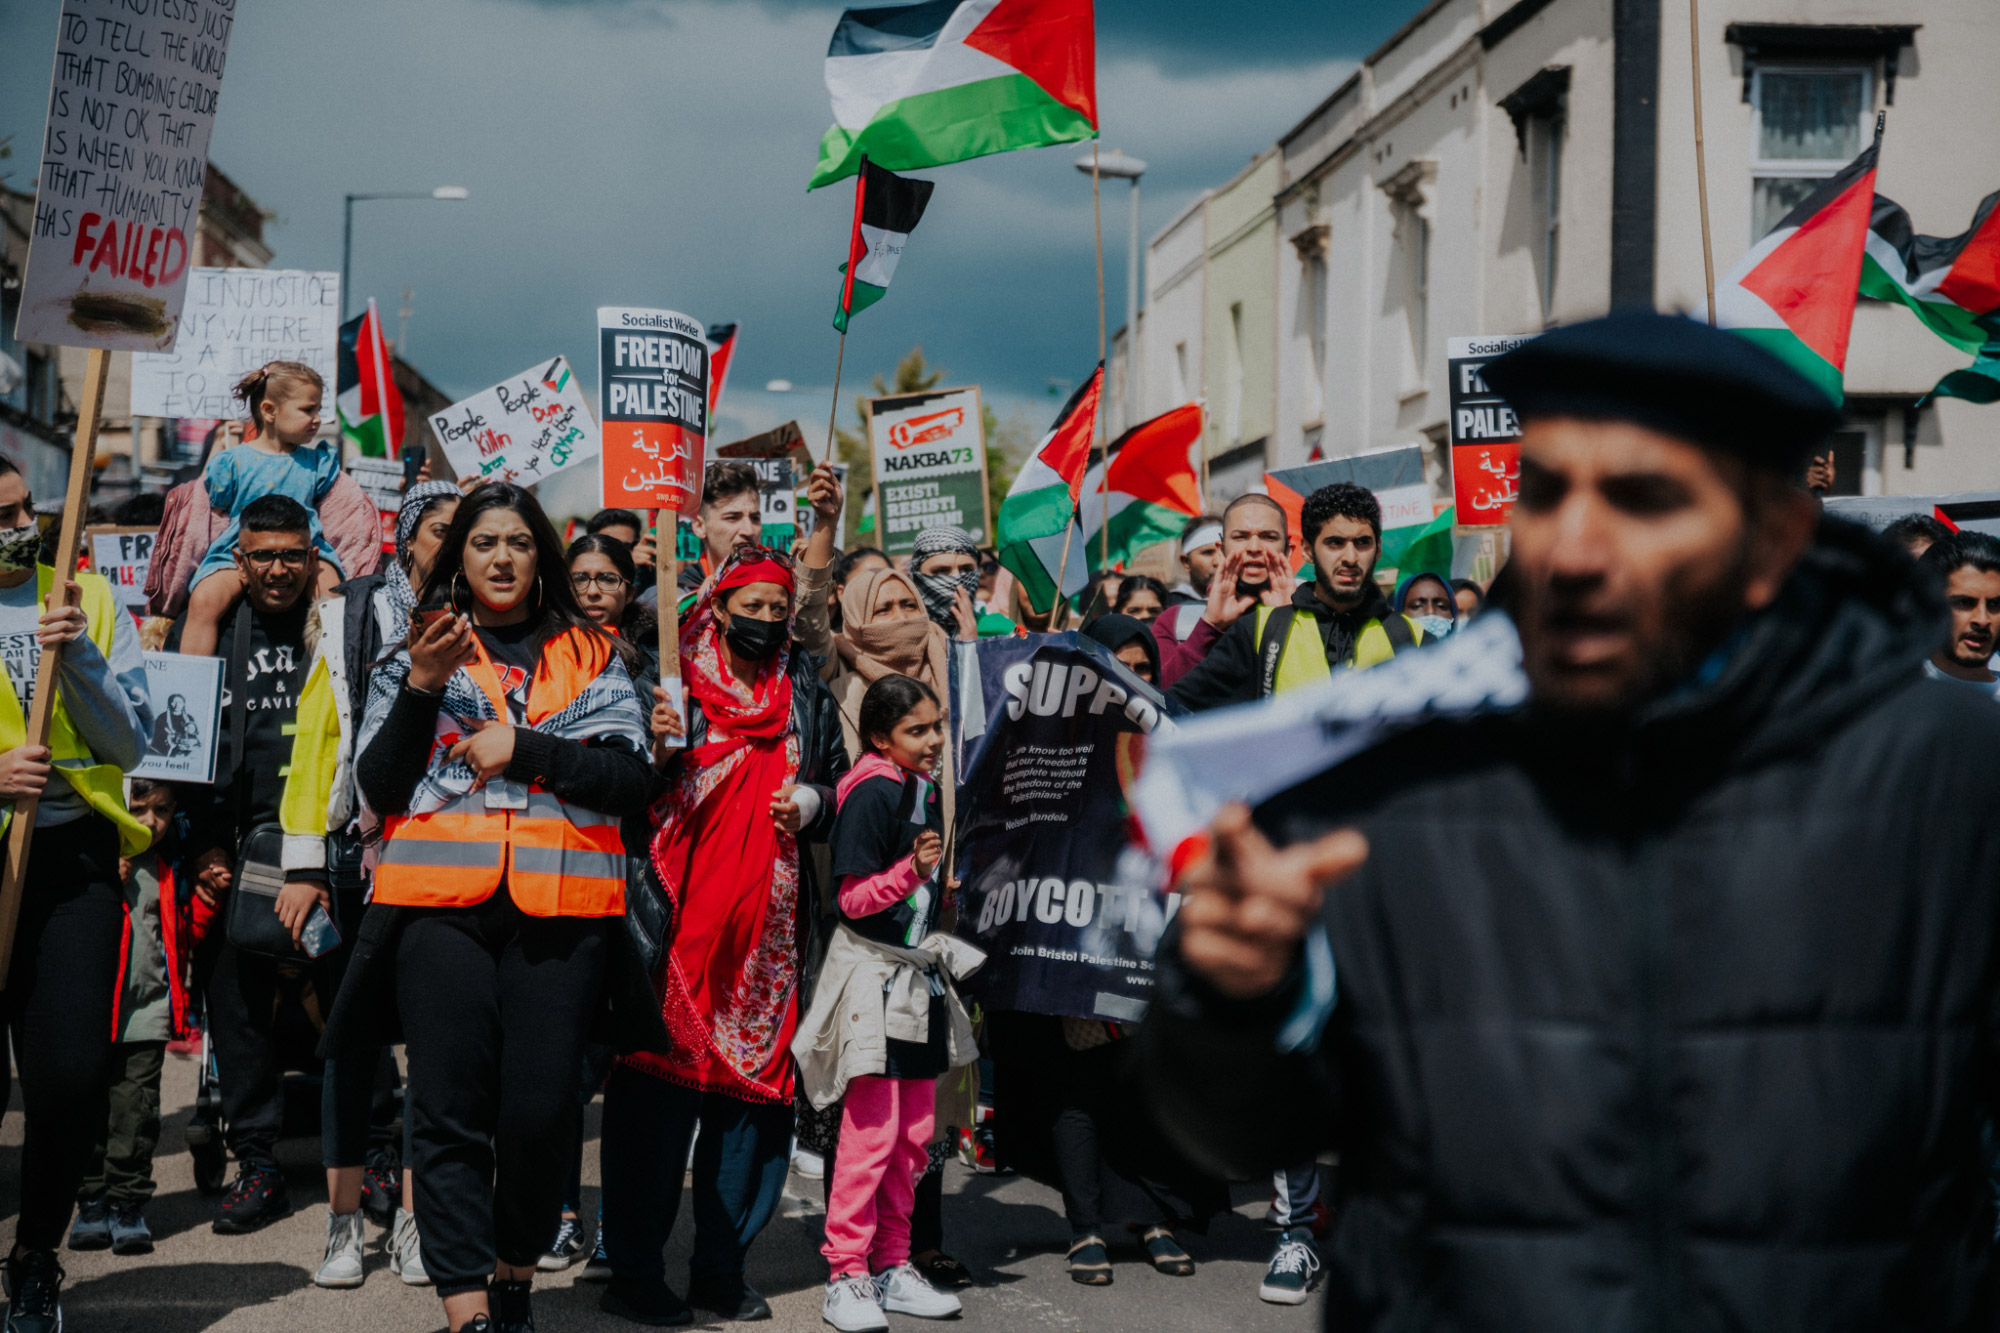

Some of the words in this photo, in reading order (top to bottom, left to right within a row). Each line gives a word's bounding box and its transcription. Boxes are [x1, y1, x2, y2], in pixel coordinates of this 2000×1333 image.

[197, 7, 234, 48] JUST
[63, 13, 88, 45] TO
[96, 18, 151, 58] TELL
[161, 31, 189, 62] THE
[191, 41, 226, 80] WORLD
[57, 51, 111, 92] THAT
[115, 61, 178, 109] BOMBING
[51, 86, 70, 118] IS
[81, 96, 118, 134] NOT
[124, 108, 151, 144] OK
[158, 113, 197, 149] THAT
[46, 126, 68, 155] IS
[77, 133, 135, 173] WHEN
[142, 151, 169, 185] YOU
[43, 161, 96, 200] THAT
[95, 172, 194, 240] HUMANITY
[34, 200, 73, 239] HAS
[72, 211, 188, 289] FAILED
[199, 275, 337, 309] INJUSTICE
[181, 313, 313, 343] NYWHERE
[622, 312, 673, 330] Socialist
[198, 344, 218, 366] A
[614, 335, 702, 380] FREEDOM
[157, 371, 206, 395] TO
[662, 369, 680, 386] for
[435, 408, 487, 444] People
[496, 380, 541, 415] People
[609, 383, 703, 428] PALESTINE
[1457, 407, 1524, 439] PALES
[473, 427, 512, 458] Killin
[885, 482, 940, 502] EXIST!
[886, 496, 956, 518] RESIST!
[887, 510, 964, 534] RETURN!
[119, 534, 153, 561] FR
[100, 565, 148, 587] PALES
[0, 634, 36, 650] EST
[1263, 642, 1280, 701] llesse
[276, 681, 286, 693] &
[1004, 661, 1174, 735] SUPPO
[246, 696, 301, 711] CAVI
[1019, 758, 1036, 766] our
[1036, 757, 1077, 767] freedom
[1078, 756, 1088, 766] is
[1028, 745, 1057, 755] know
[1058, 747, 1074, 756] too
[1075, 744, 1095, 754] well
[1003, 768, 1048, 783] incomplete
[1050, 769, 1087, 778] without
[1003, 785, 1015, 795] the
[1015, 779, 1052, 791] freedom
[1054, 780, 1066, 789] of
[1066, 780, 1082, 789] the
[1005, 817, 1029, 831] Nelson
[1030, 812, 1069, 822] Mandela
[976, 878, 1149, 934] BOYCOTT
[1010, 946, 1035, 956] Join
[1037, 947, 1078, 962] Bristol
[1080, 953, 1137, 970] Palestine
